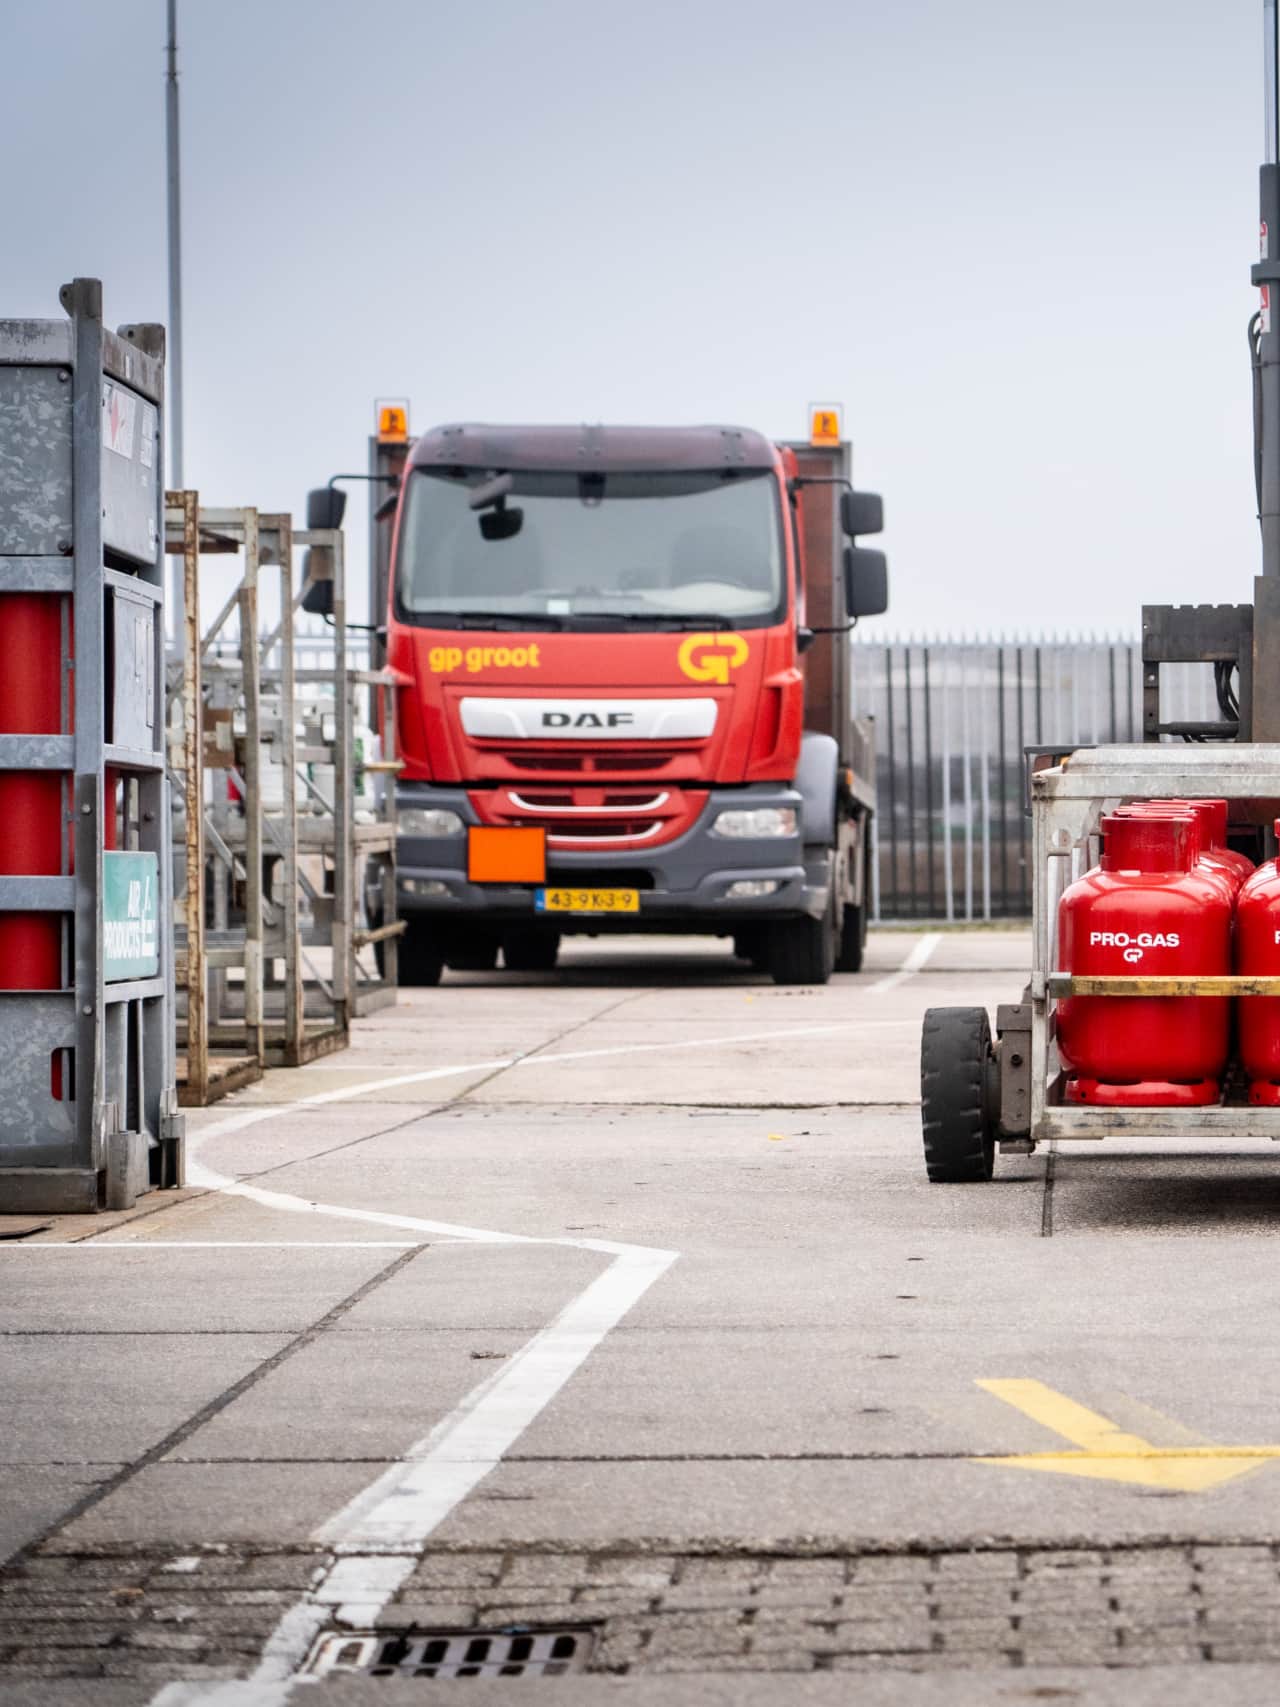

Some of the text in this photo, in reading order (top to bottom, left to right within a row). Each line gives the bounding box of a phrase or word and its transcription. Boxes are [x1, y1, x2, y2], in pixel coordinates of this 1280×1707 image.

[429, 643, 541, 673] gp groot
[541, 712, 634, 728] DAF
[1090, 931, 1180, 948] PRO-GAS
